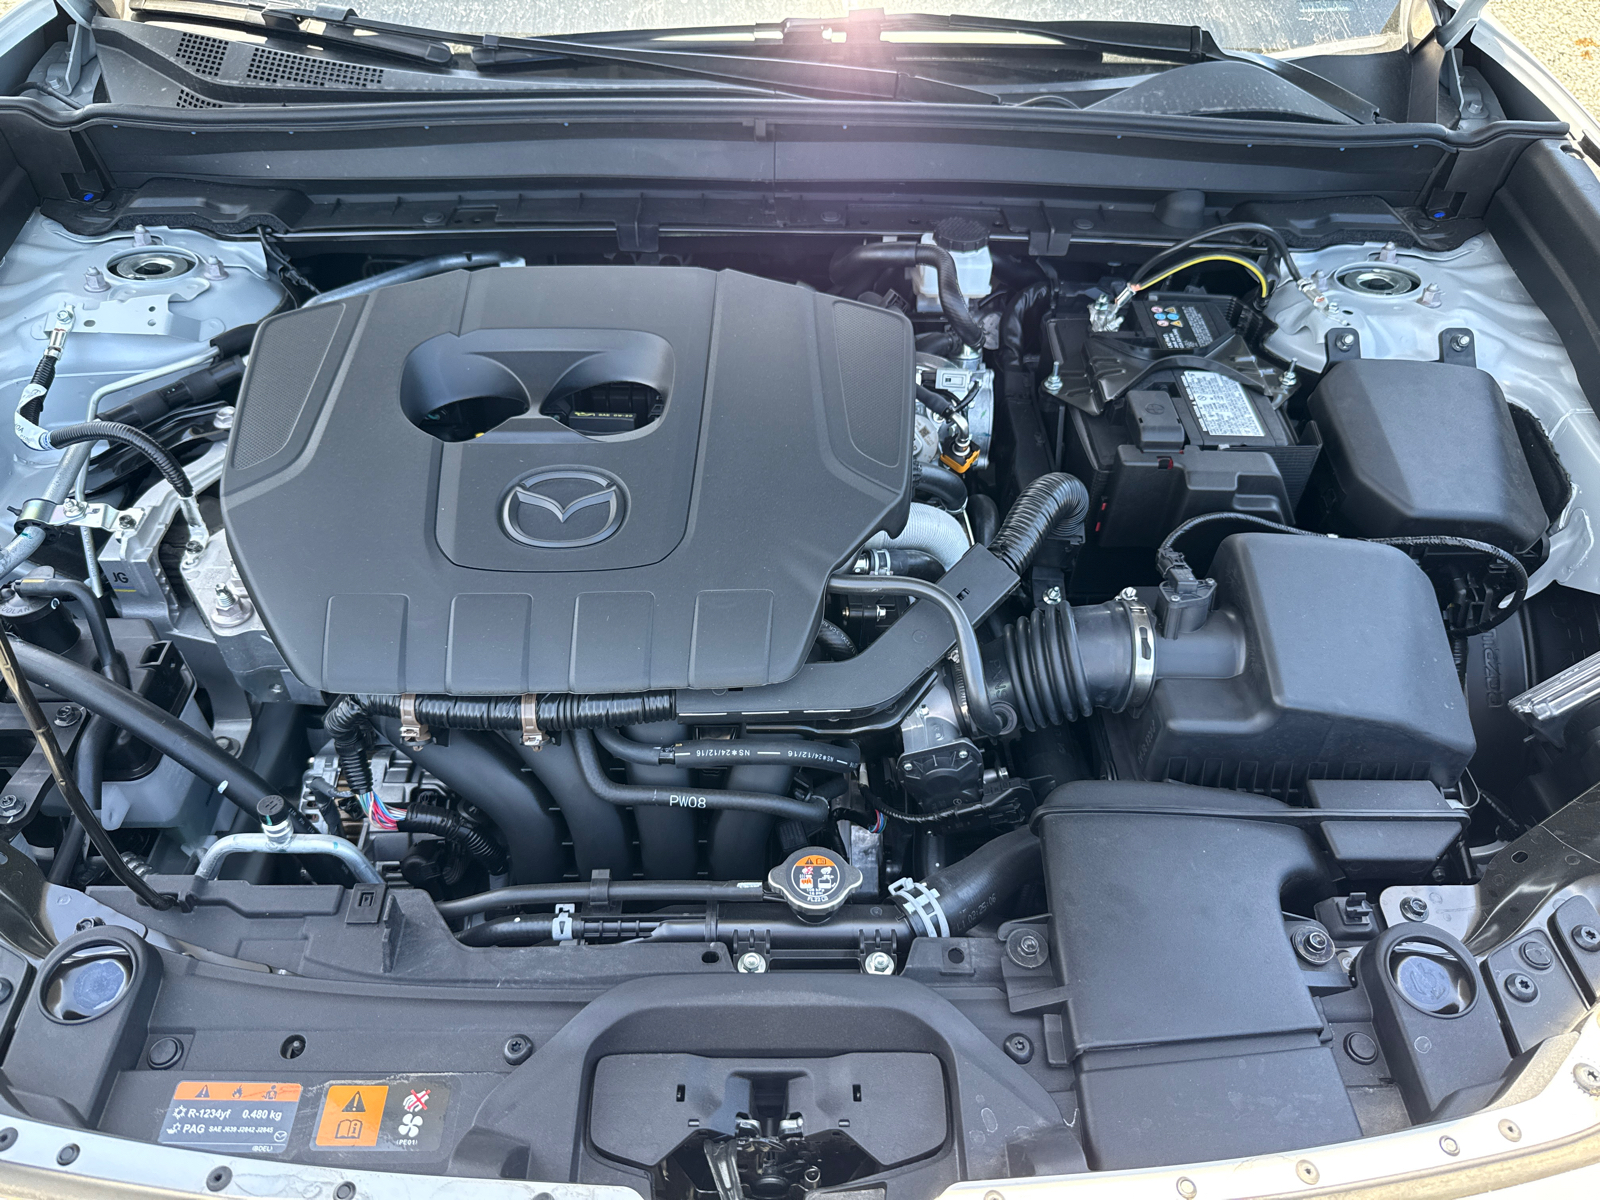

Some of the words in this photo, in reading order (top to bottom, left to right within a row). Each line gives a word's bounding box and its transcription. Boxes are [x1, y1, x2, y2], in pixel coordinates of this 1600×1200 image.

[112, 571, 129, 584] JG
[669, 794, 707, 809] PW08
[187, 1108, 231, 1120] R-1234yf
[242, 1109, 267, 1120] 0.480
[268, 1110, 282, 1121] kg
[182, 1123, 206, 1135] PAG
[208, 1125, 222, 1133] SAE
